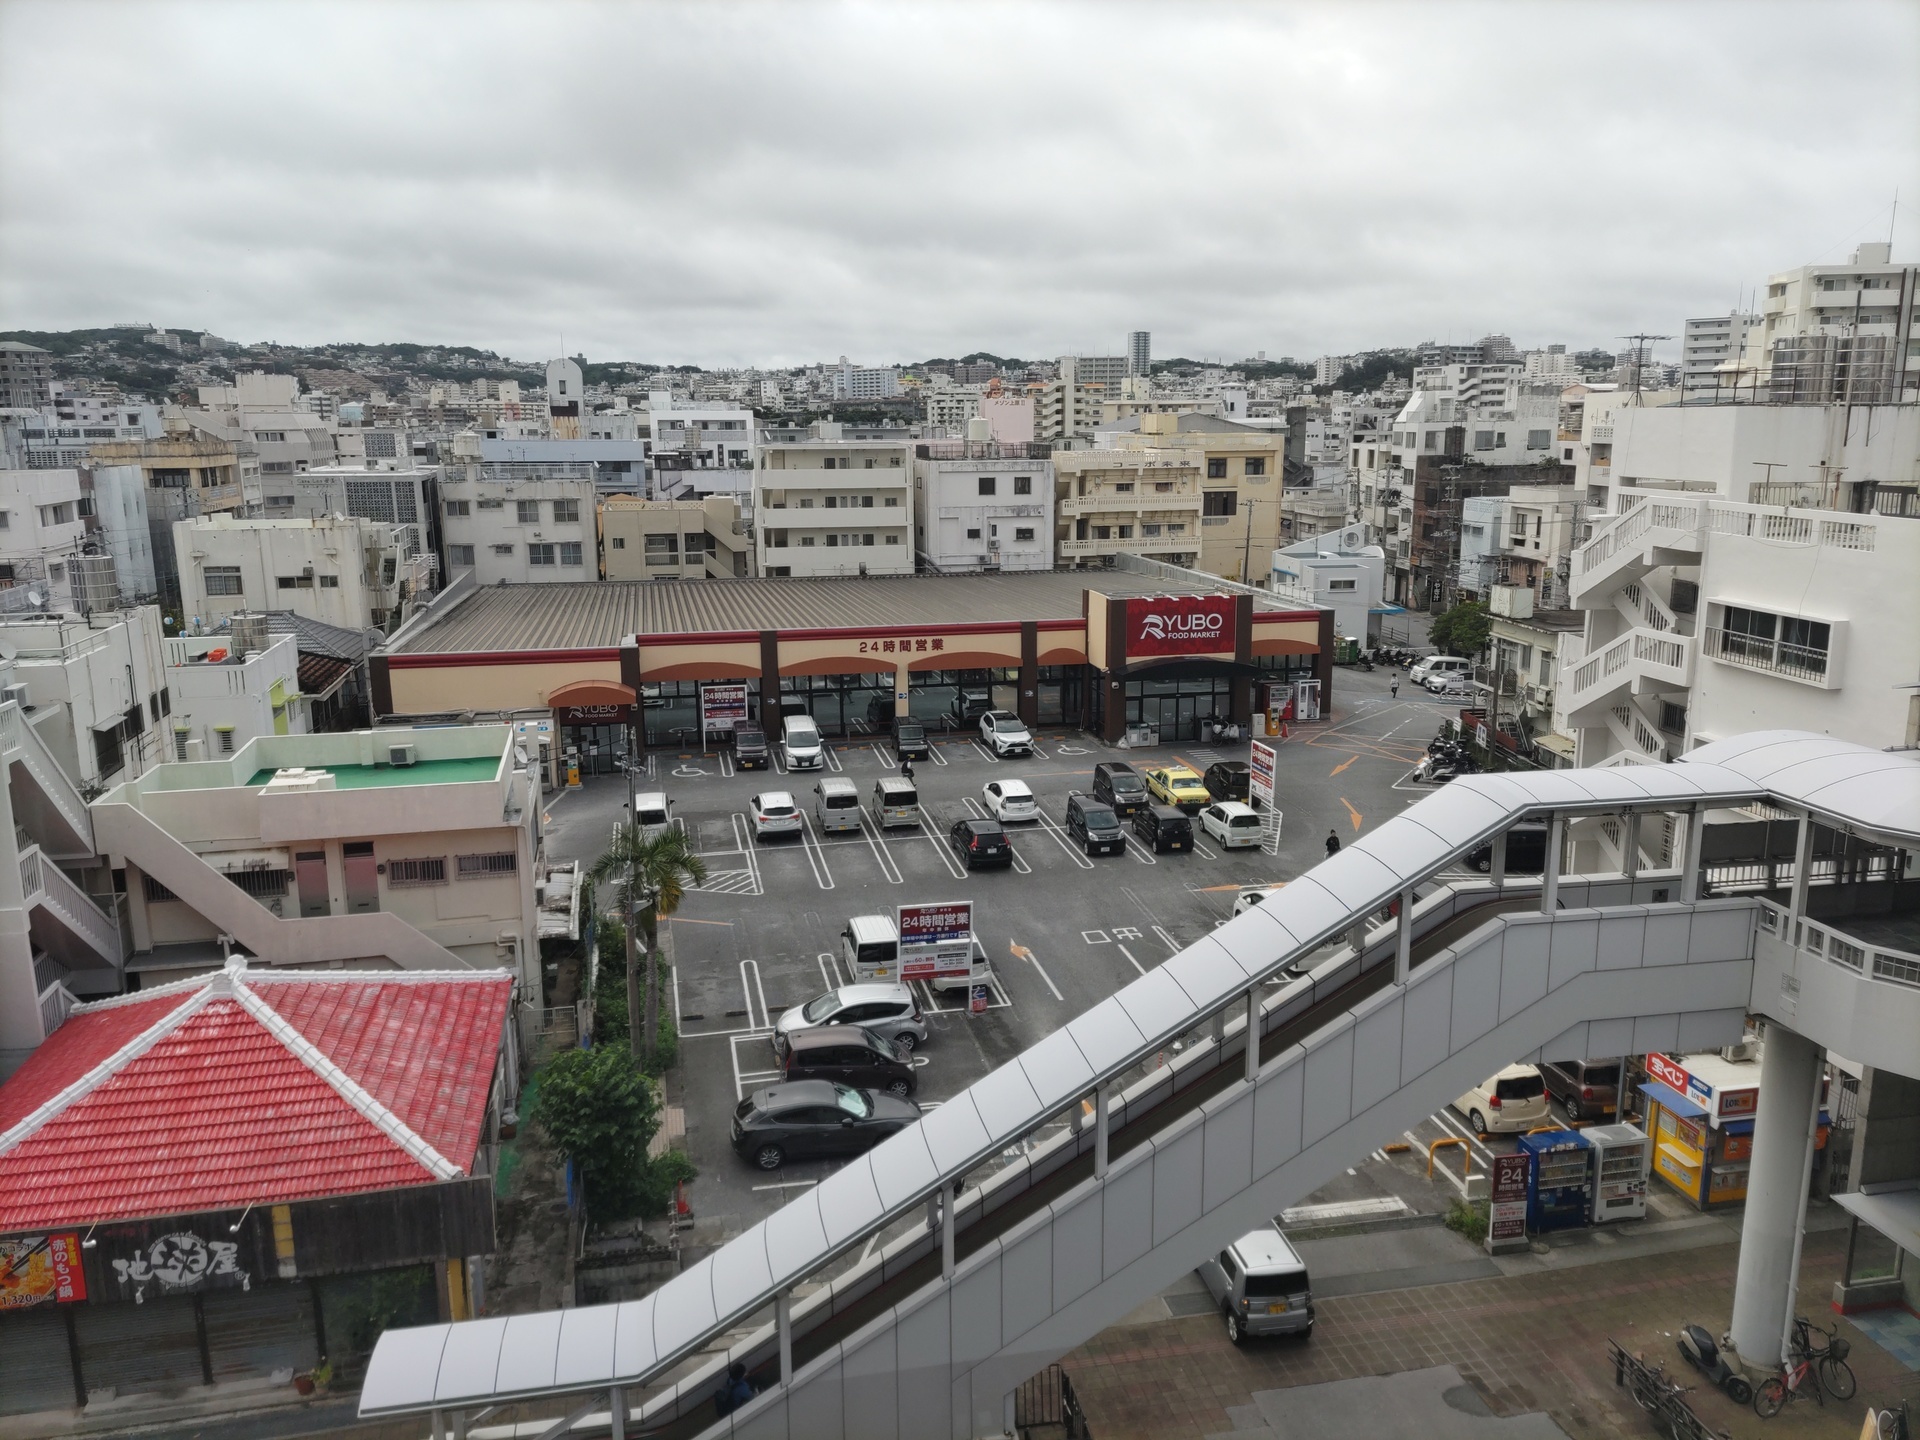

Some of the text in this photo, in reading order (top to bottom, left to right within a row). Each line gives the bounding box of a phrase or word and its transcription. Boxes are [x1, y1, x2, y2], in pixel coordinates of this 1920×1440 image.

[1112, 460, 1191, 468] コーポ未来
[1140, 613, 1223, 640] RYUBO
[1168, 630, 1221, 640] FOOD MARKET
[859, 638, 944, 653] 24時間営業
[704, 691, 745, 700] 24時間営業
[568, 704, 619, 719] RYUBO
[902, 912, 969, 928] 24時間営業
[1651, 1056, 1684, 1087] 宝くじ
[1501, 1168, 1523, 1184] 24
[52, 1239, 74, 1298] 赤のもつ鍋
